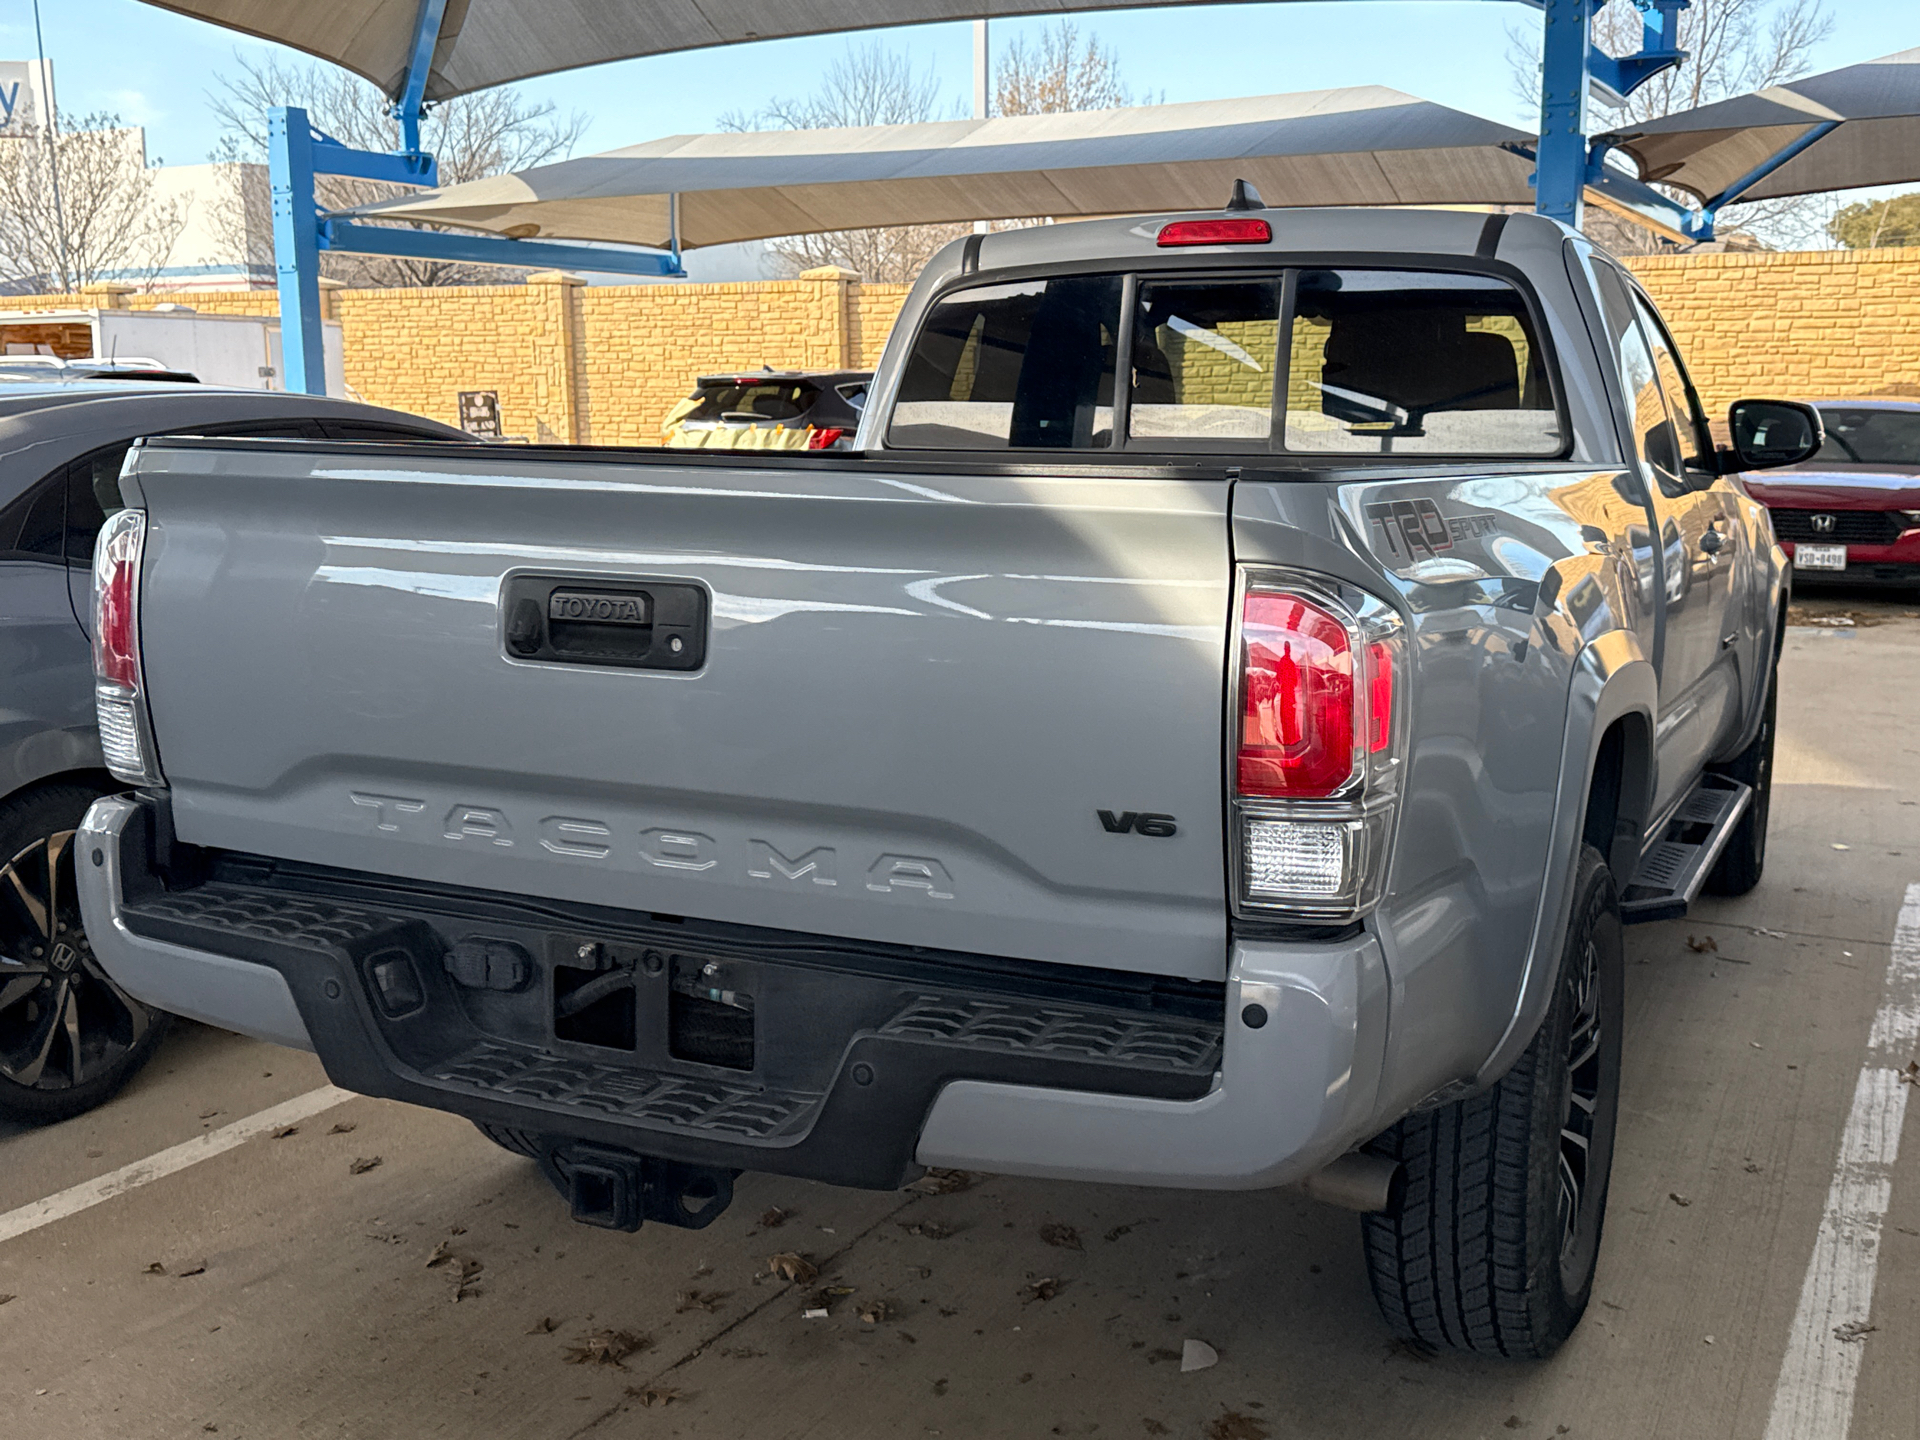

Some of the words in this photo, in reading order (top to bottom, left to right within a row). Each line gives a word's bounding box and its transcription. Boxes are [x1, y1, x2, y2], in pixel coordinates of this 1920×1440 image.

[1364, 498, 1453, 564] TRD
[1450, 514, 1500, 542] SPORT
[555, 596, 641, 621] TOYOTA
[350, 791, 955, 900] TACOMA
[1096, 809, 1177, 838] V6
